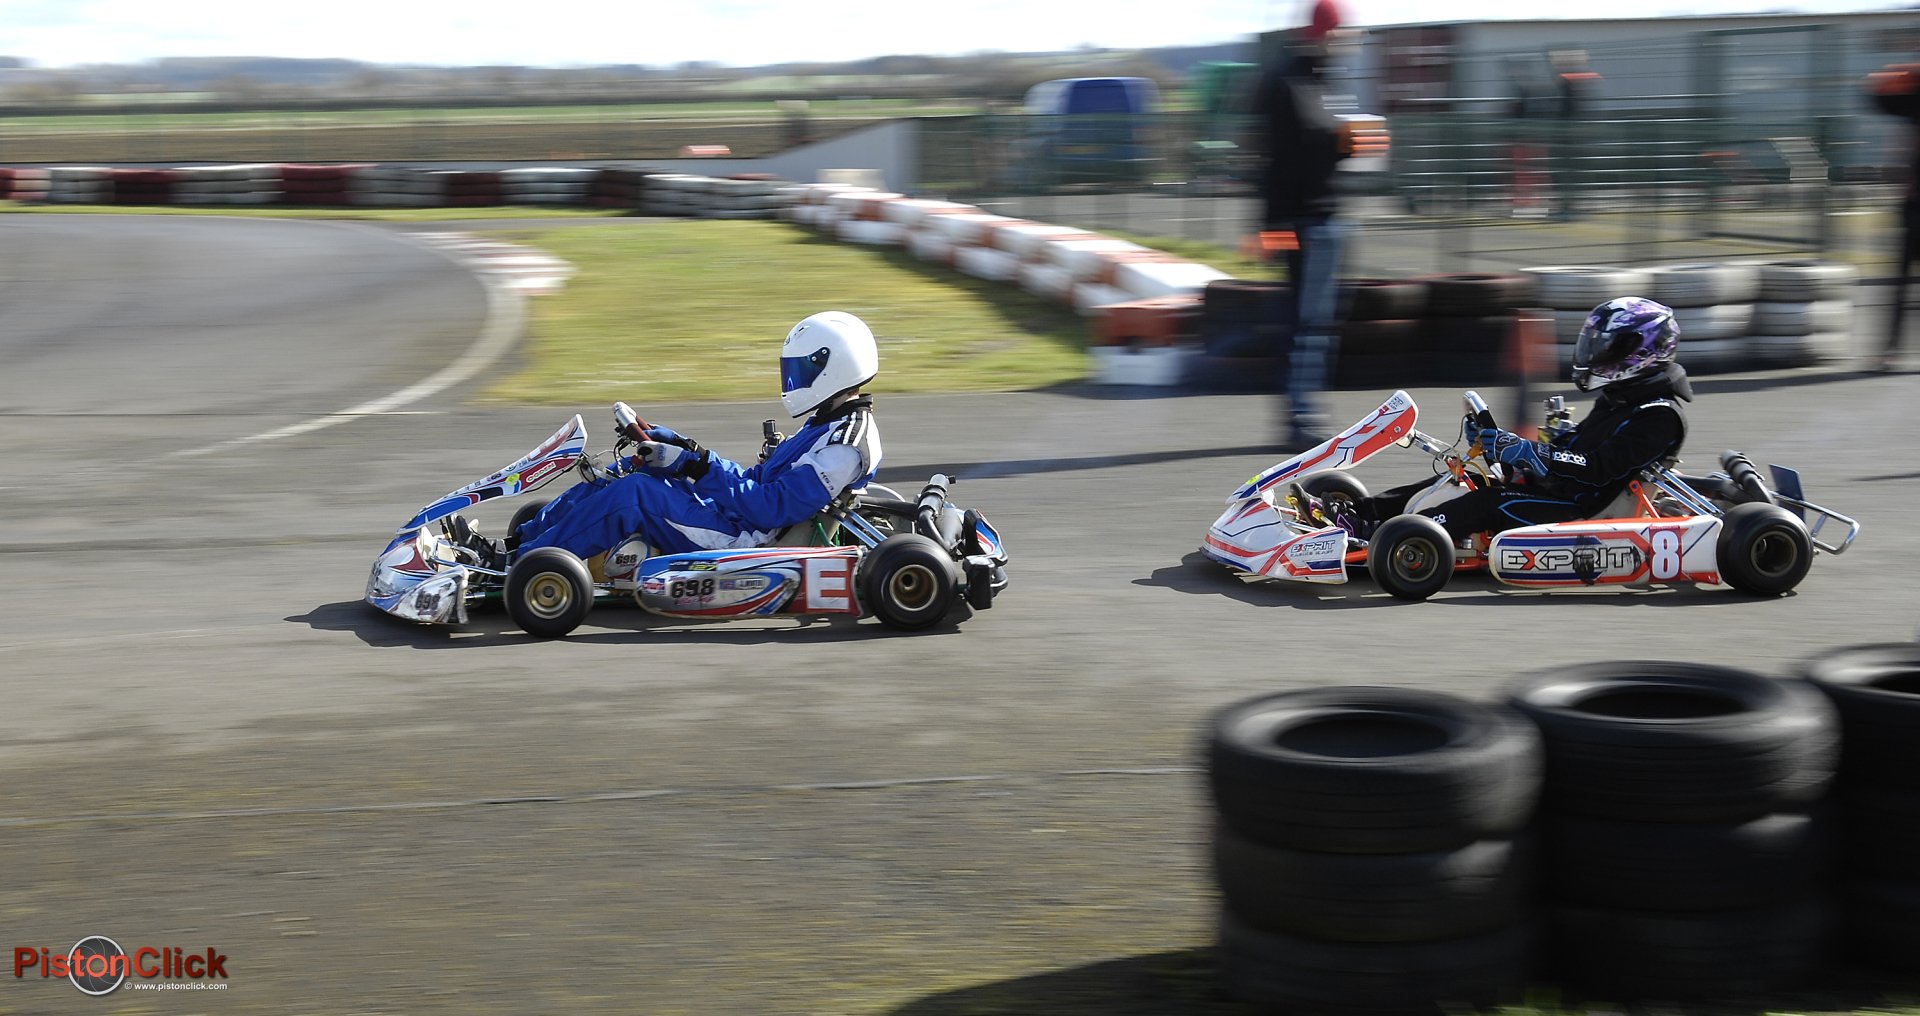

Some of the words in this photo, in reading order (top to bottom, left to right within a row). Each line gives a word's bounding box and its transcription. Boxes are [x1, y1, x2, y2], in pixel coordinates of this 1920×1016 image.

[1291, 539, 1336, 553] EXPRIT
[1652, 530, 1681, 580] 8
[615, 554, 638, 565] 698
[1501, 547, 1631, 571] EXPRIT
[672, 579, 714, 598] 698
[806, 558, 849, 610] E
